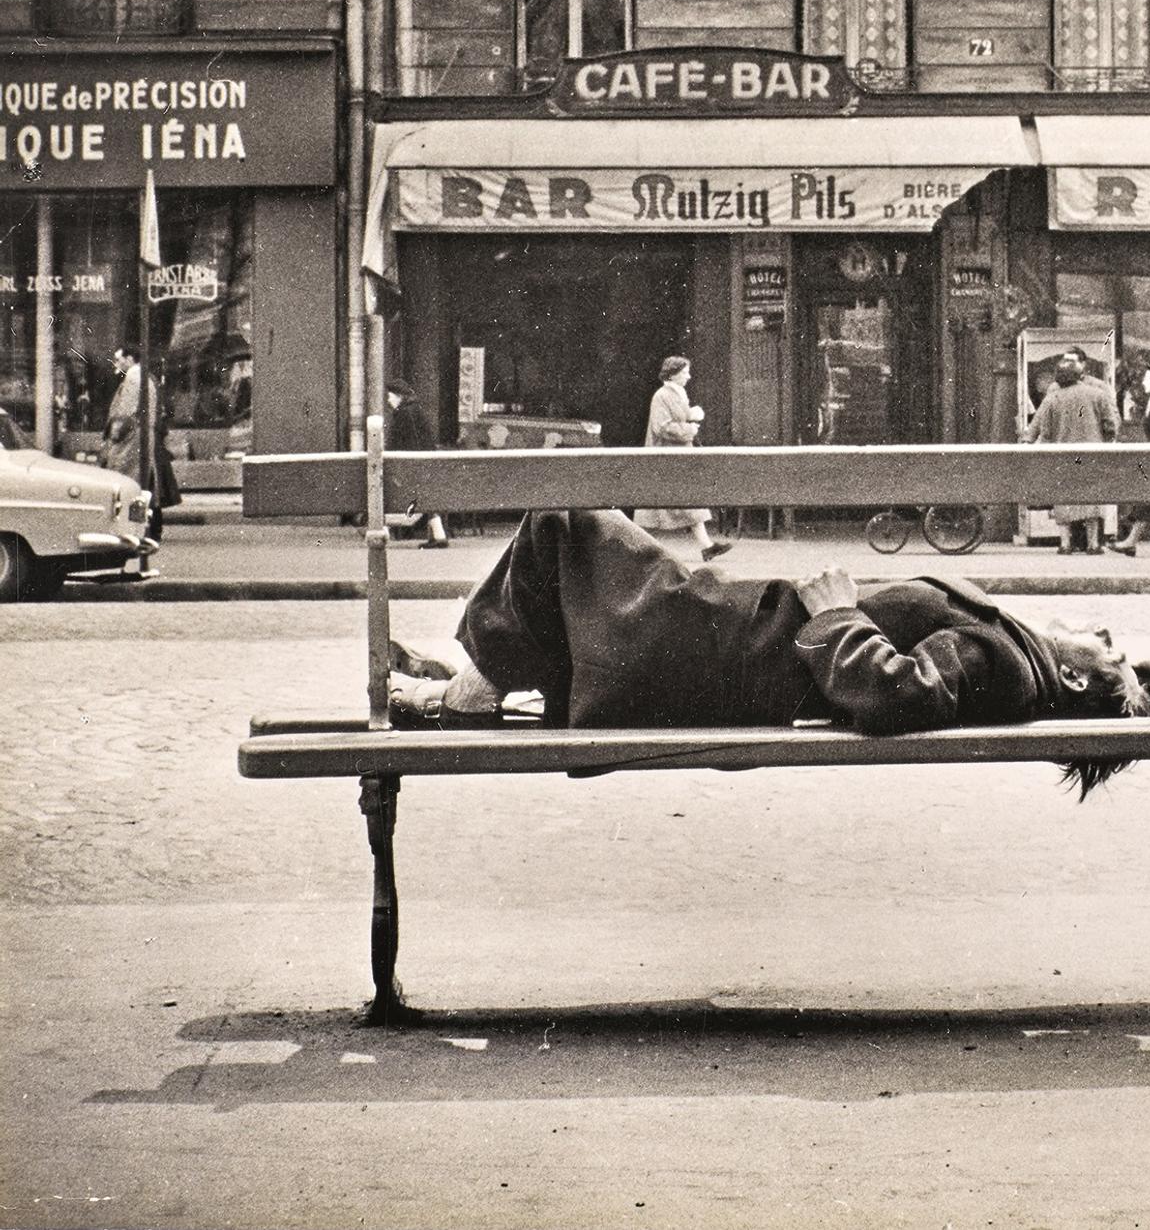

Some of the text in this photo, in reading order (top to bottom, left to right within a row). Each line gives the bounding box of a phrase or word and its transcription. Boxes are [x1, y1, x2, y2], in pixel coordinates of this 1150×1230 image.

[971, 39, 992, 56] 72
[95, 78, 246, 110] PRÉCISION
[142, 117, 246, 160] IÉNA
[441, 176, 592, 220] BAR
[791, 172, 856, 221] Pils
[27, 275, 63, 292] ZSS
[72, 274, 105, 291] JENA
